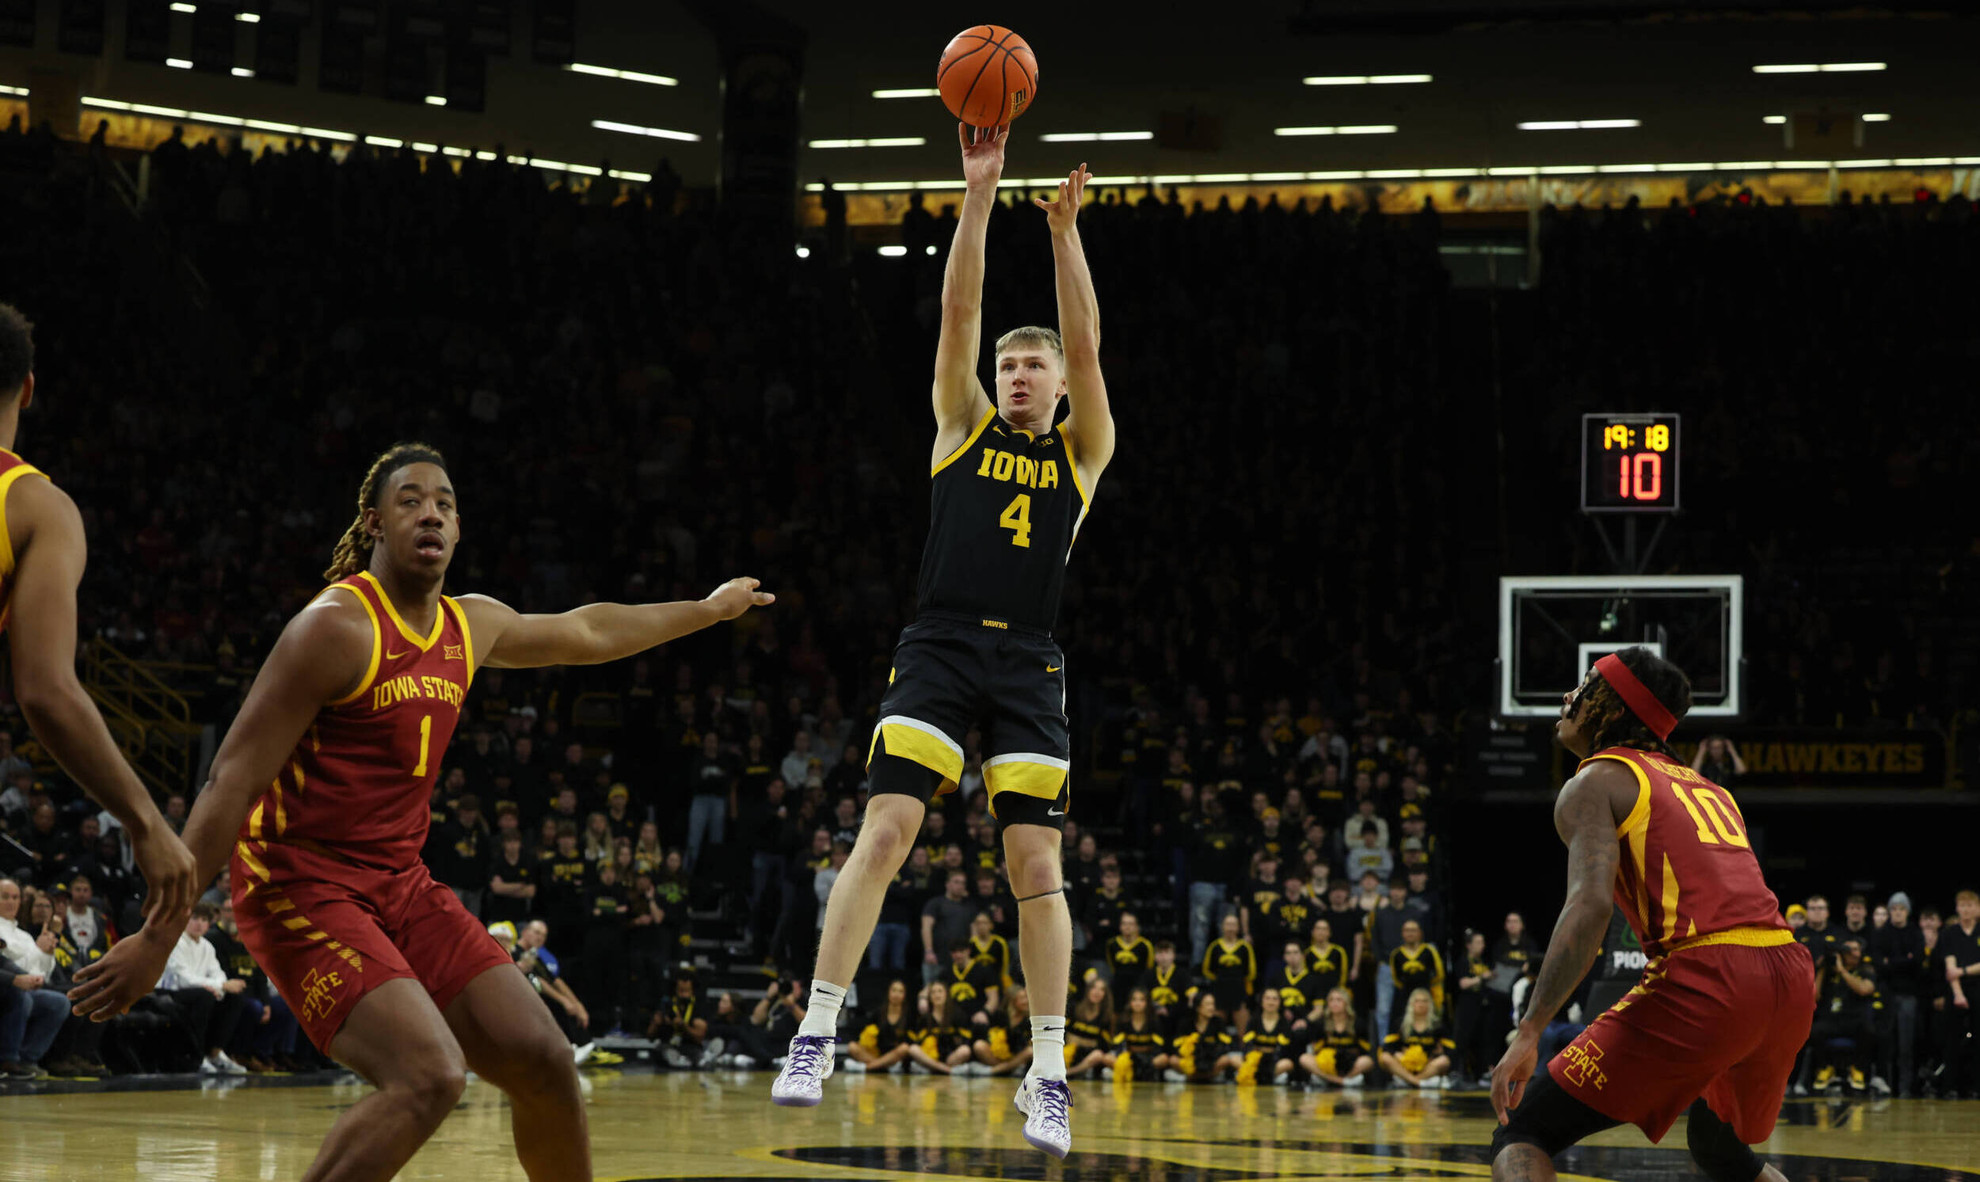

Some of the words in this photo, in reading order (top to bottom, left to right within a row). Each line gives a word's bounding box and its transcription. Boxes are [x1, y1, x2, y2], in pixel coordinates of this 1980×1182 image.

[1604, 424, 1669, 452] 19:18
[977, 447, 1059, 490] IOWA
[1620, 452, 1662, 500] 10
[999, 493, 1032, 549] 4
[982, 619, 1008, 629] HAWKS
[372, 675, 421, 712] IOWA
[412, 714, 432, 777] 1
[1741, 741, 1925, 774] HAWKEYES
[1671, 781, 1749, 848] 10
[303, 971, 344, 1022] STATE
[1562, 1045, 1608, 1091] STATE
